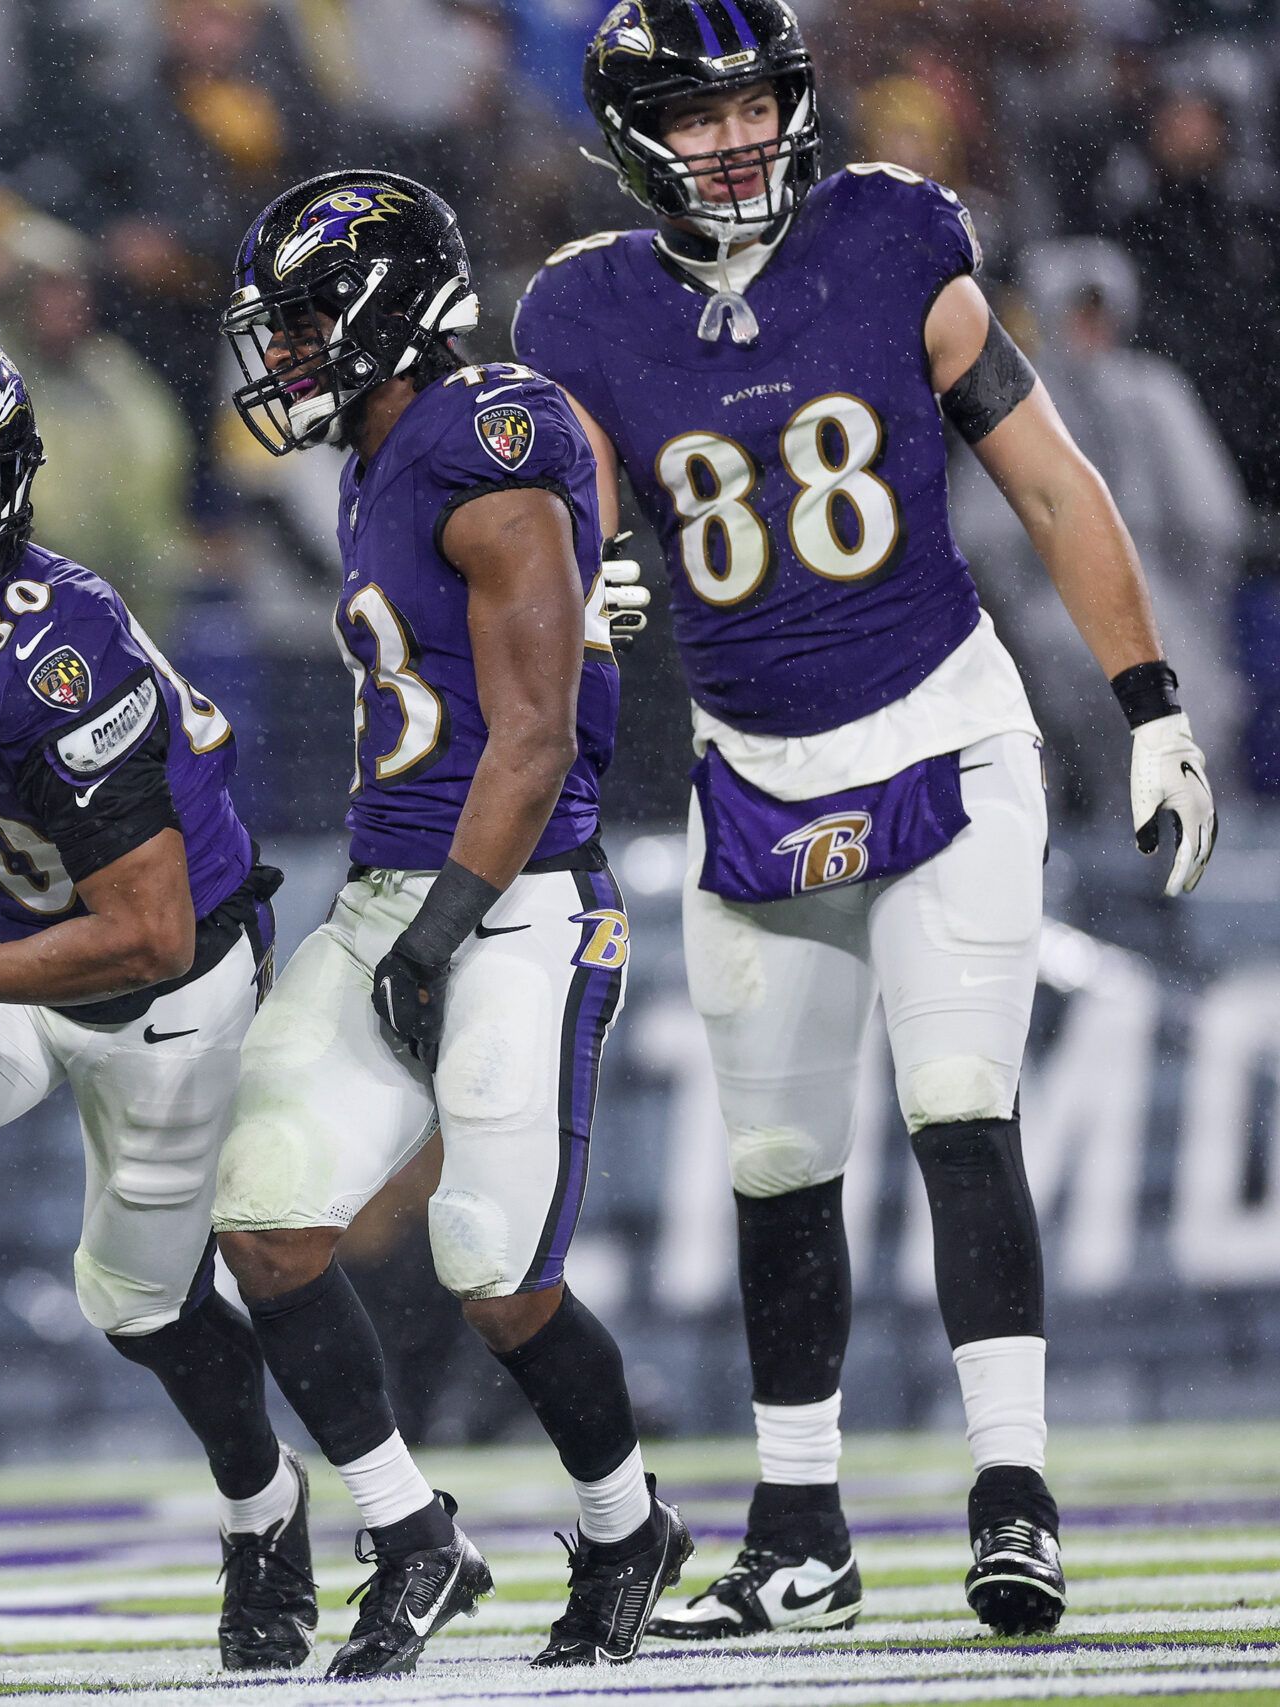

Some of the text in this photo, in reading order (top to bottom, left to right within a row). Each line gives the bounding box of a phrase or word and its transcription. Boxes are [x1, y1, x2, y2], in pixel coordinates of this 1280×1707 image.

[481, 409, 523, 421] RAVENS
[720, 381, 794, 407] RAVENS
[654, 391, 900, 607] 88
[33, 651, 70, 684] RAVENS
[771, 811, 873, 897] B
[570, 908, 630, 969] B
